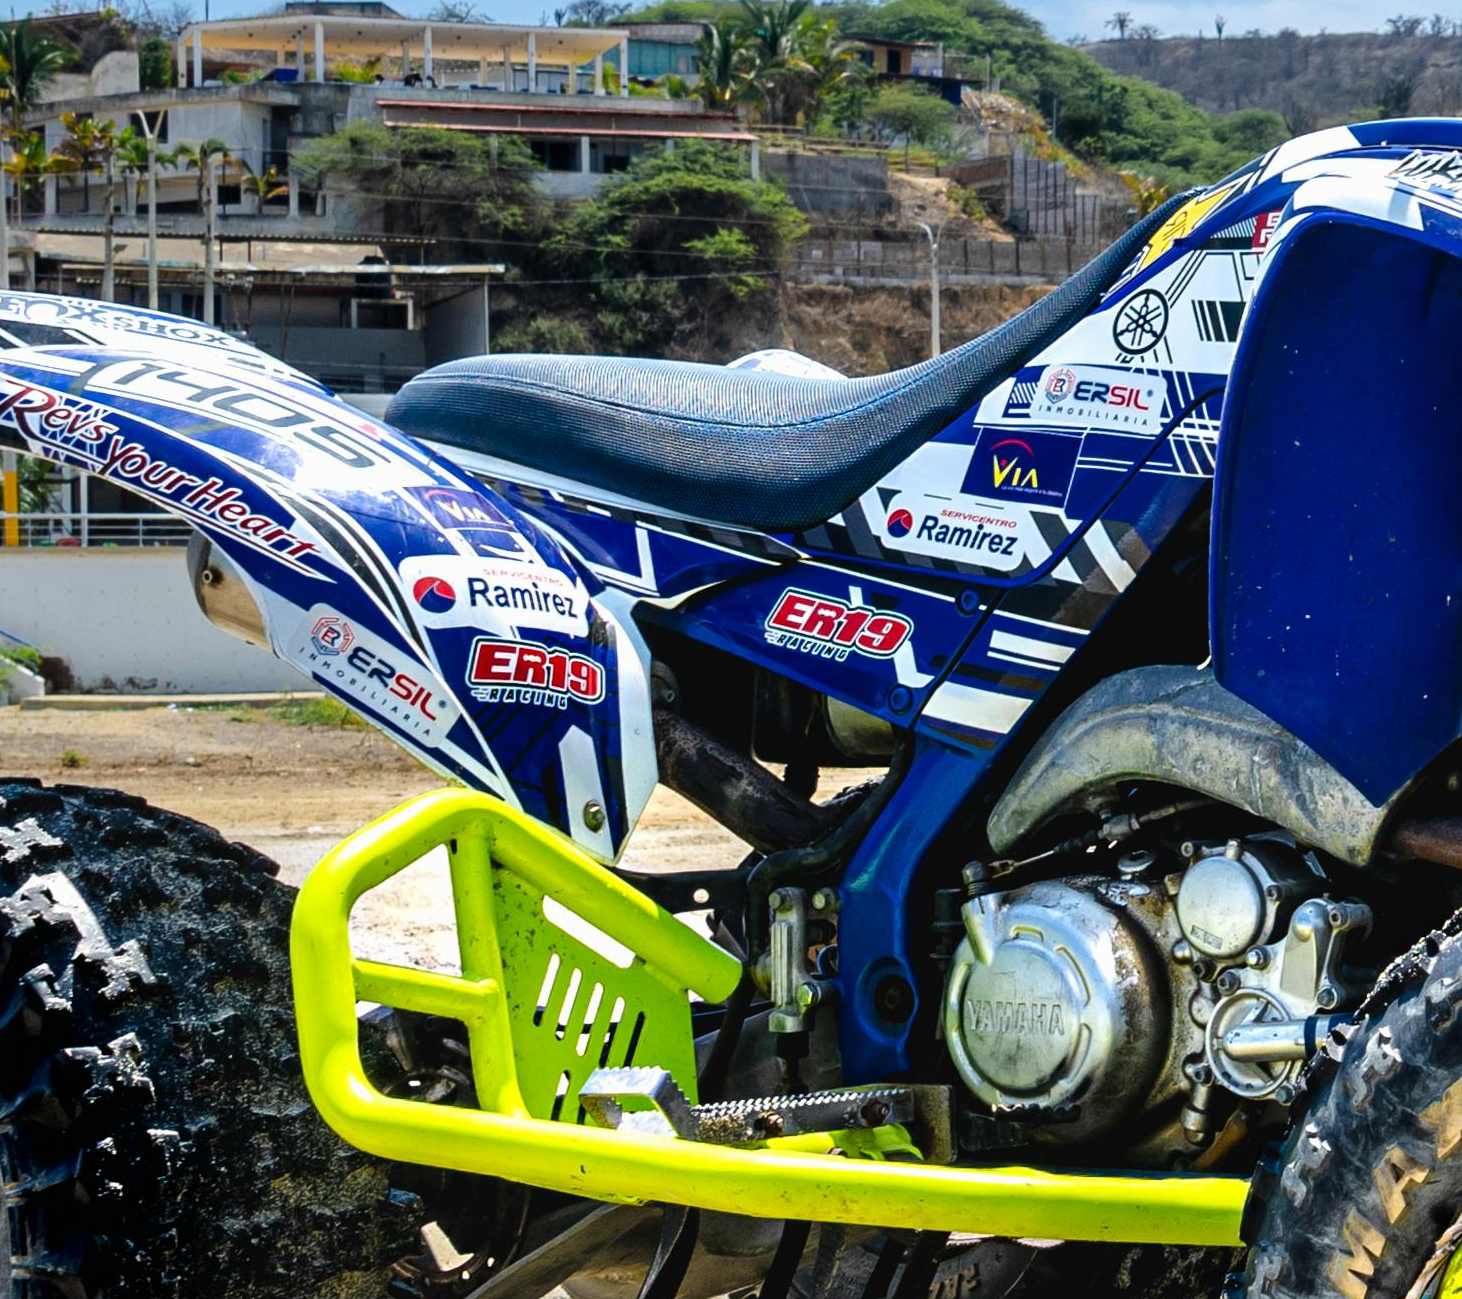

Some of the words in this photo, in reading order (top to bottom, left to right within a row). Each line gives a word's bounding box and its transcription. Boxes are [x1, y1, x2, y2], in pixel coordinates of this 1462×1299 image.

[1038, 404, 1148, 426] INMOBILIARIA
[1073, 380, 1149, 411] ERSIL
[184, 477, 320, 558] Heart
[916, 514, 1019, 557] Ramirez
[940, 508, 1018, 529] SERVICENTRO
[467, 576, 579, 620] Ramirez
[770, 592, 911, 653] ER19
[775, 631, 849, 661] RACING
[298, 646, 432, 738] INMOBILIARIA
[347, 645, 437, 722] ERSIL
[472, 642, 599, 701] ER19
[487, 688, 568, 709] RACING
[966, 998, 1066, 1037] YAMAHA
